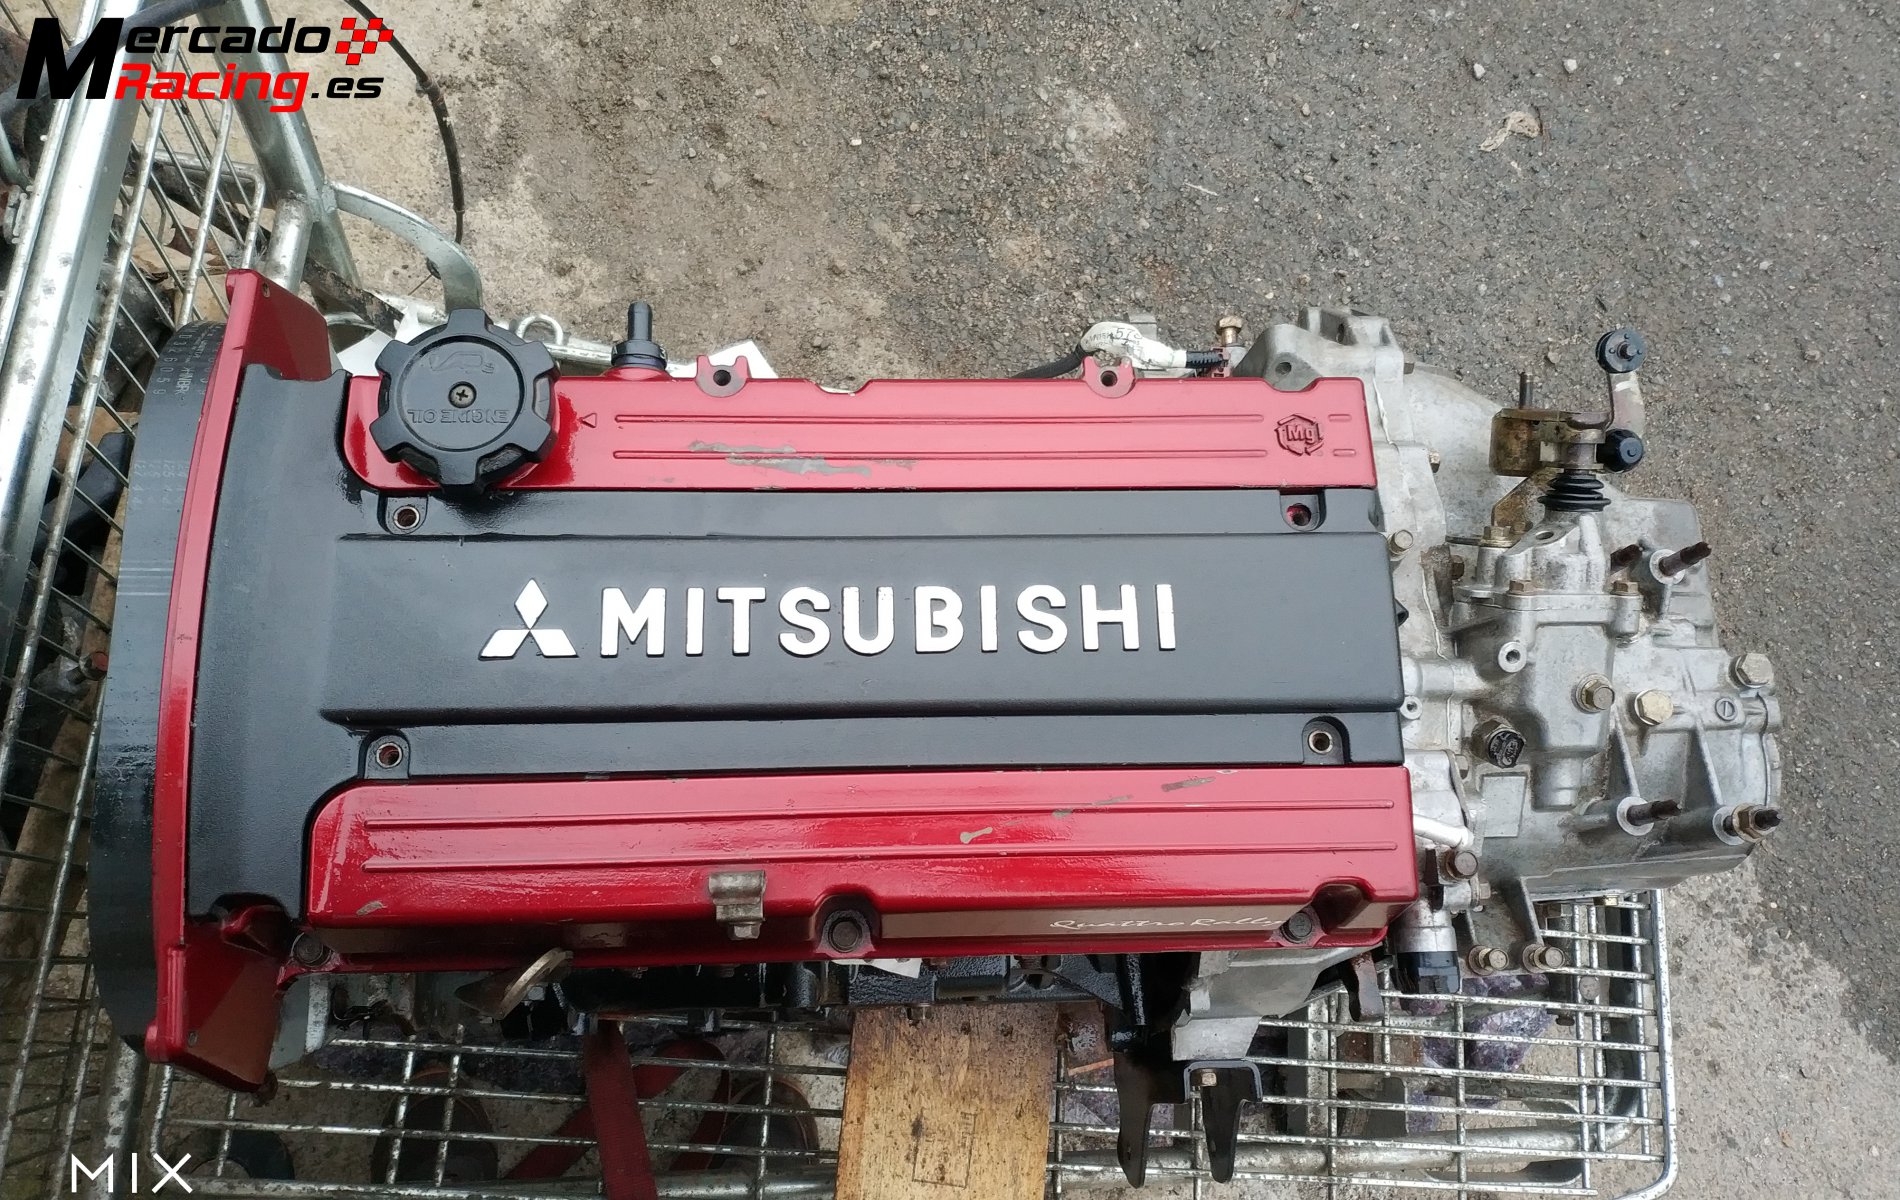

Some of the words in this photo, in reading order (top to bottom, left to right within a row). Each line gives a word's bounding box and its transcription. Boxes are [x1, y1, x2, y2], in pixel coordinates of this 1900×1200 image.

[408, 408, 437, 424] OIL
[441, 408, 511, 424] ENGINE
[1286, 424, 1315, 445] Mg
[600, 583, 1177, 658] MITSUBISHI
